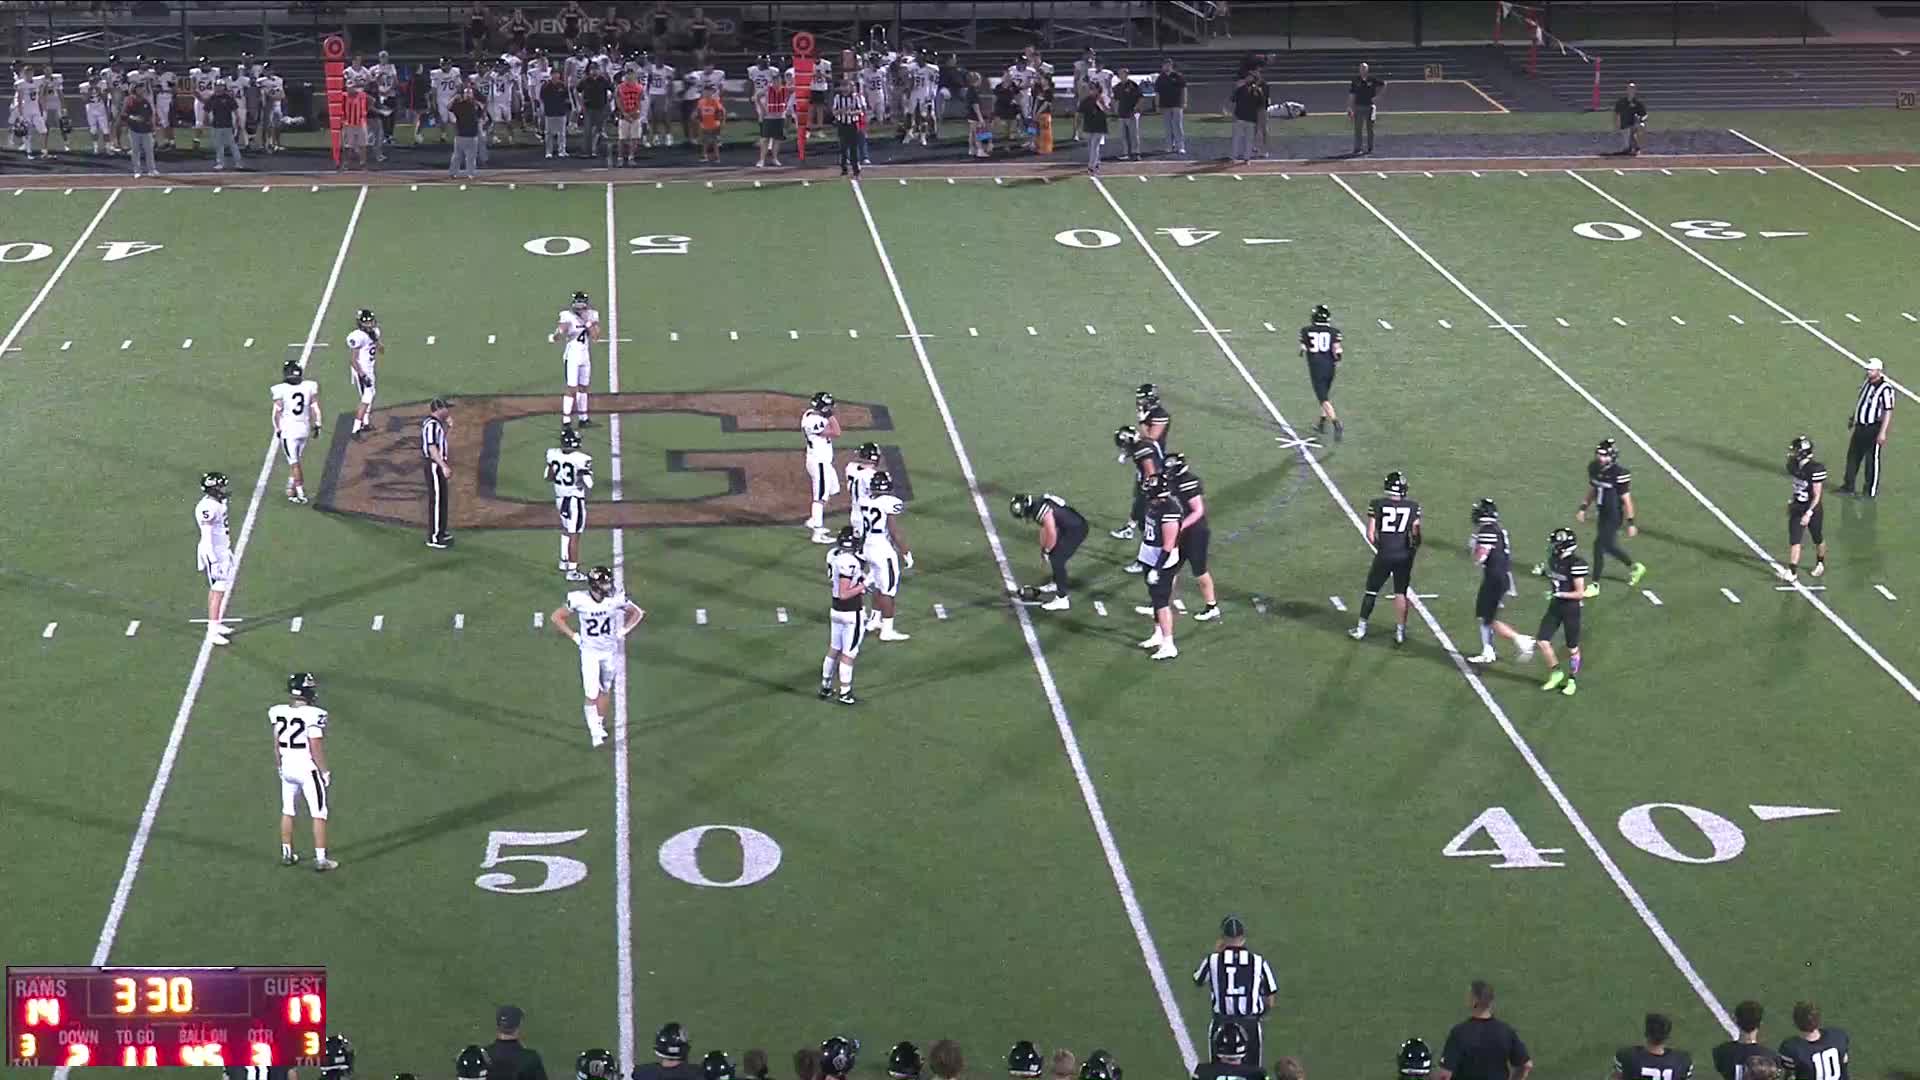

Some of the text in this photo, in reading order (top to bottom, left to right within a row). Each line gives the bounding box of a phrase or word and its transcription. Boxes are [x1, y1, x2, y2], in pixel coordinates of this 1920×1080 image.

[441, 80, 455, 91] 70
[1308, 332, 1330, 352] 30
[292, 392, 304, 416] 3
[813, 421, 825, 430] 44
[552, 460, 574, 486] 23
[861, 506, 882, 533] 52
[1382, 507, 1410, 532] 27
[586, 617, 611, 637] 24
[276, 716, 307, 749] 22
[1226, 967, 1245, 994] L
[1812, 1048, 1841, 1080] 10
